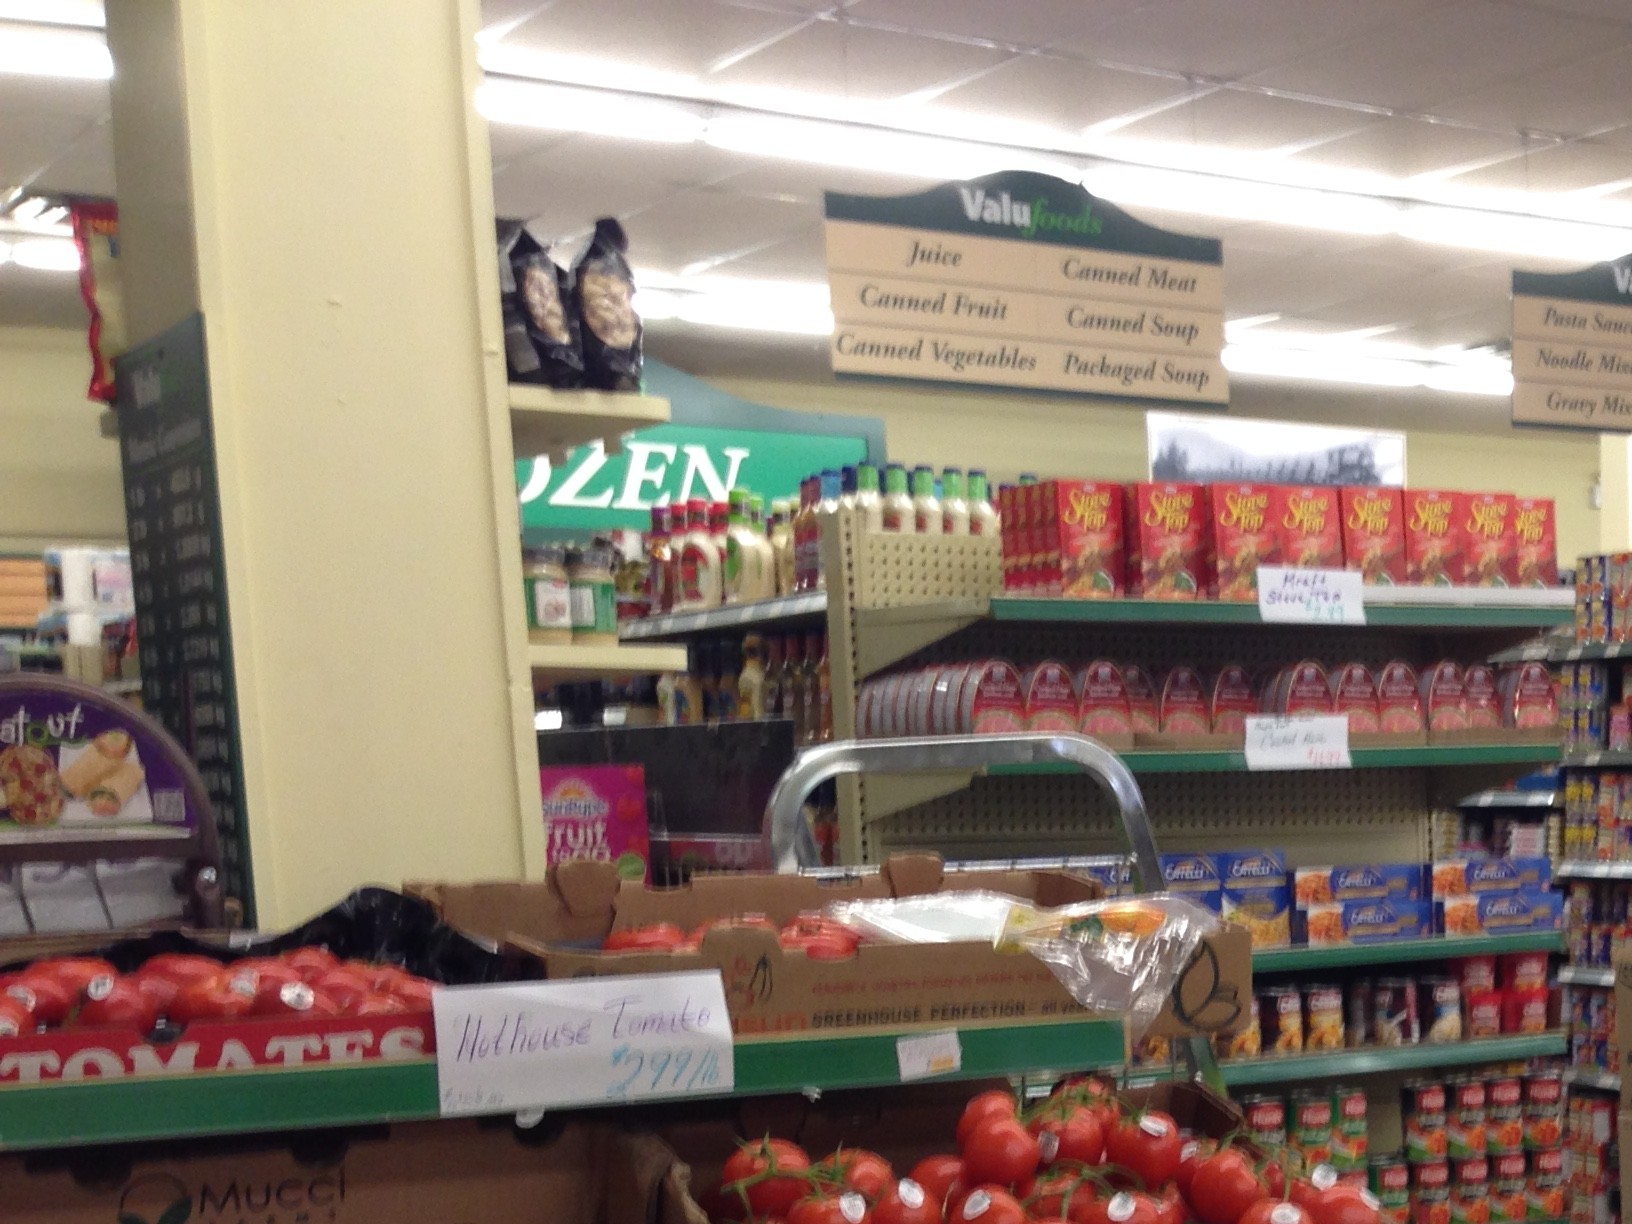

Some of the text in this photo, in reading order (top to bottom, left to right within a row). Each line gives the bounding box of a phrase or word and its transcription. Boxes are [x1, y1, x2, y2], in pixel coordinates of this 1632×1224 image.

[906, 240, 963, 268] Juice
[1062, 256, 1198, 294] Canned Meat
[858, 283, 1008, 322] Canned Fruit
[1544, 307, 1588, 329] Pasta
[1065, 305, 1200, 346] Canned Soup
[836, 333, 1037, 373] Canned Vegetables
[1063, 350, 1210, 390] Packaged Soup
[1536, 349, 1593, 371] Noodle
[1546, 392, 1597, 418] Gravy
[456, 1012, 593, 1063] Hothouse
[603, 994, 711, 1041] Tomato
[811, 1007, 922, 1030] GREENHOUSE
